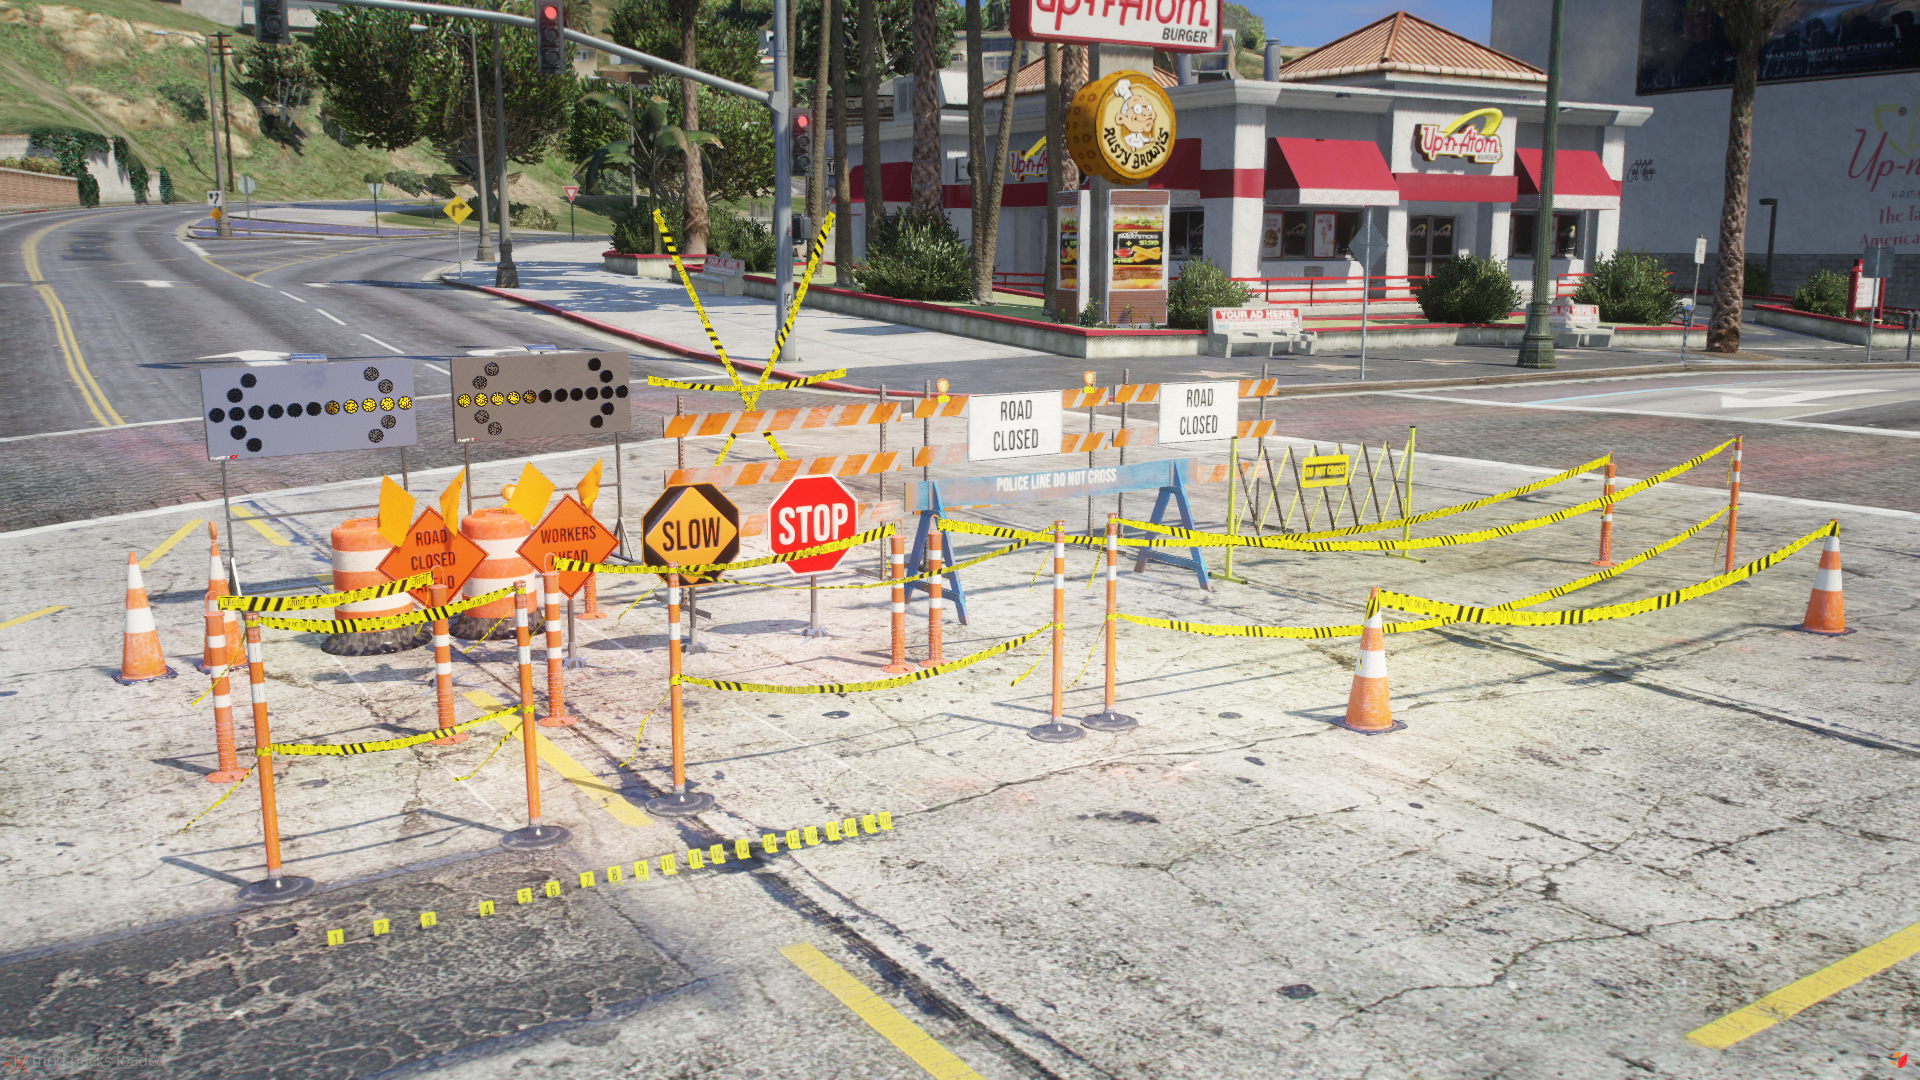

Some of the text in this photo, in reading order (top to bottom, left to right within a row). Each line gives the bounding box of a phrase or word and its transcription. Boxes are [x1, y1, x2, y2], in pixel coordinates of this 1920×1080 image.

[1162, 27, 1208, 43] BURGER
[1765, 41, 1895, 59] MAKING MOTION PICTURES
[1104, 127, 1131, 165] RUSTY
[1879, 206, 1904, 225] The
[1219, 309, 1295, 319] YOUR AD HERE!
[1186, 388, 1214, 408] ROAD
[1000, 399, 1033, 422] ROAD
[1179, 415, 1218, 436] CLOSED
[993, 428, 1039, 452] CLOSED
[1306, 465, 1346, 476] DO NOT CROSS
[996, 467, 1117, 493] POLICE LINE DO NOT CROSS
[778, 502, 849, 546] STOP
[416, 528, 448, 546] ROAD
[541, 525, 597, 544] WORKERS
[662, 516, 721, 553] SLOW
[411, 551, 456, 571] CLOSED
[223, 598, 245, 607] CROSS
[287, 599, 308, 607] CRIME
[308, 596, 329, 606] SCENE
[339, 592, 352, 602] NOT
[353, 589, 373, 600] CROSS
[1380, 593, 1453, 615] POLICE LINE DO NOT CROSS
[1488, 611, 1556, 621] POLICE LINE DO NOT CROSS
[881, 815, 891, 825] 20
[828, 825, 838, 836] 17
[846, 821, 856, 832] 18
[789, 833, 799, 844] 15
[806, 830, 816, 841] 16
[738, 843, 748, 854] 13
[764, 837, 775, 848] 14
[691, 852, 701, 864] 11
[712, 847, 722, 858] 12
[638, 864, 645, 876] 9
[662, 858, 673, 870] 10
[611, 868, 618, 881] 8
[584, 875, 591, 887] 7
[550, 884, 556, 897] 6
[521, 891, 529, 903] 5
[484, 904, 490, 915] 4
[425, 915, 432, 926] 3
[377, 922, 385, 933] 2
[333, 933, 339, 944] 1
